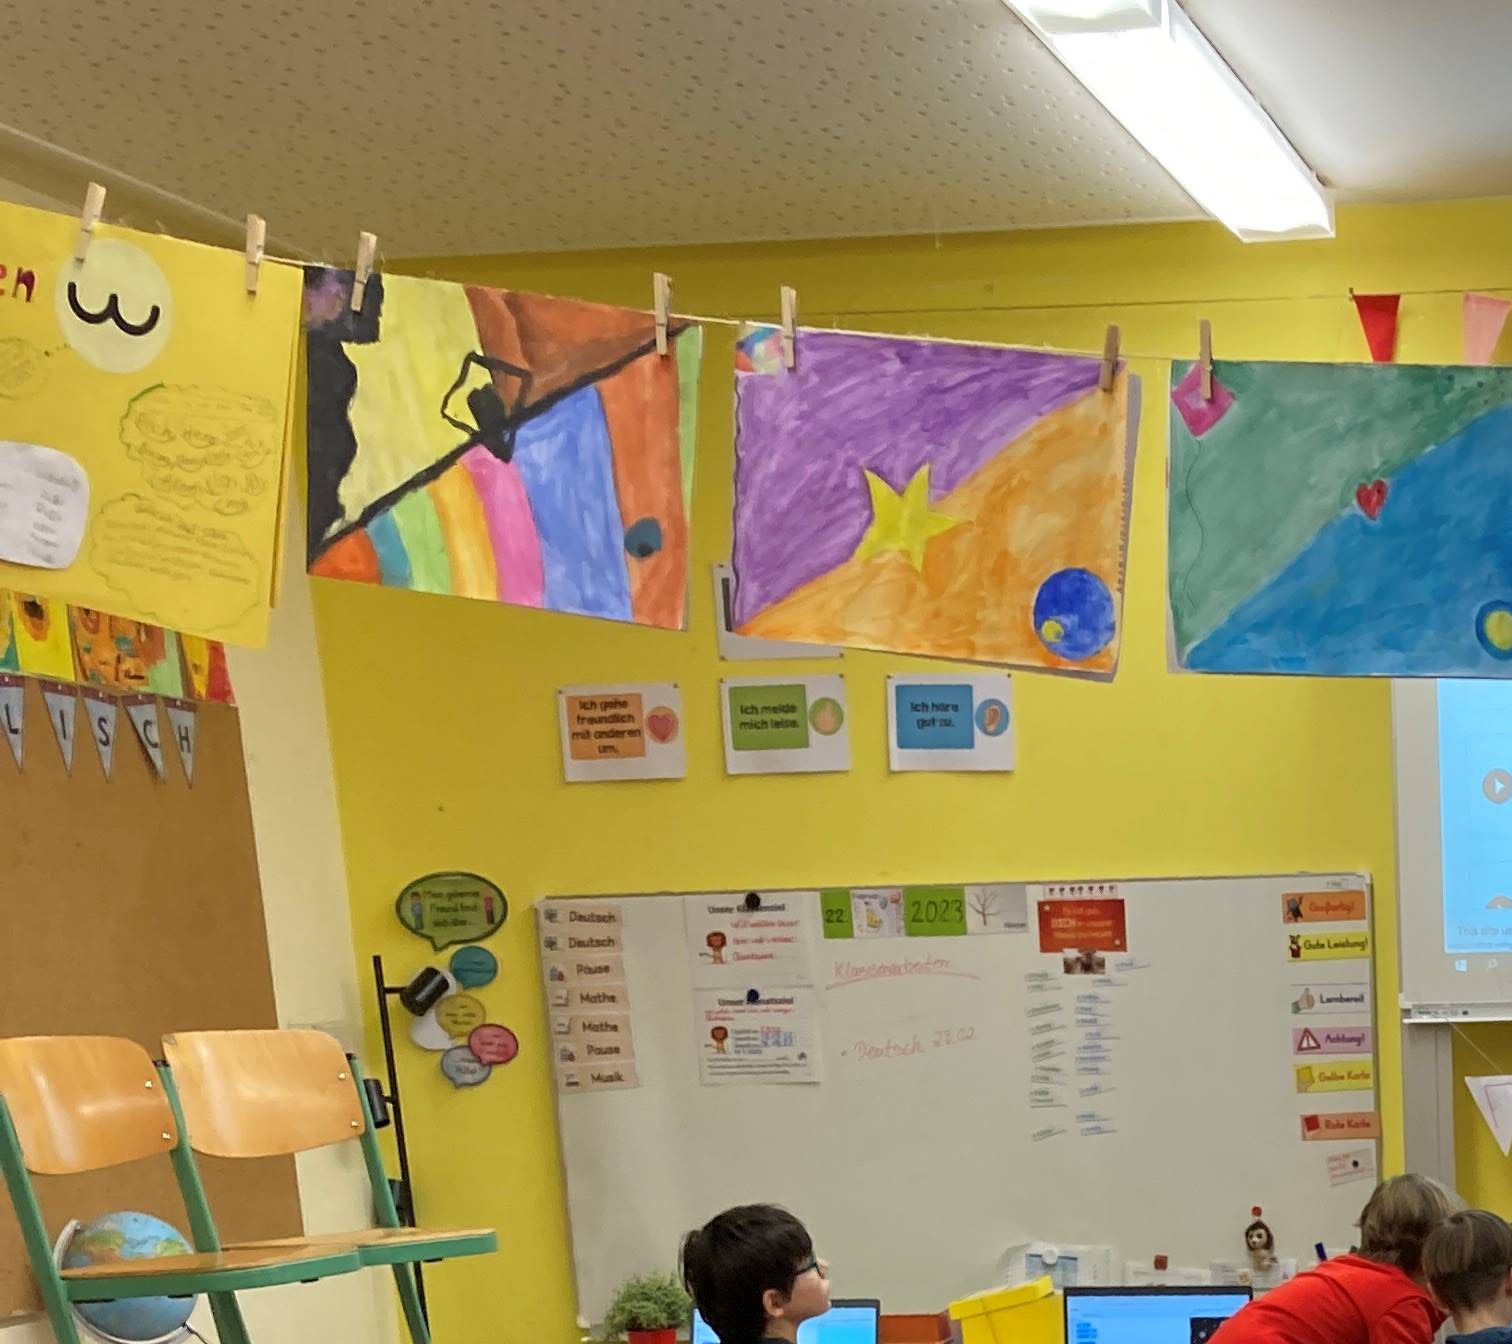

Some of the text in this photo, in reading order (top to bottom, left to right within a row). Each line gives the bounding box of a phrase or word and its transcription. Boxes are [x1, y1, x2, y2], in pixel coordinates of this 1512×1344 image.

[579, 700, 628, 712] Ich gehe
[740, 704, 797, 715] Ich melde
[910, 702, 928, 712] Ich
[577, 714, 635, 725] freundlich
[740, 719, 800, 730] mich leise.
[917, 718, 935, 730] gut
[572, 728, 642, 740] mit anderen
[569, 911, 616, 923] Deutsch
[825, 909, 845, 924] 22
[911, 900, 964, 923] 2023
[1458, 926, 1478, 936] This
[1481, 926, 1499, 936] site
[568, 936, 615, 948] Deutsch
[1303, 937, 1369, 951] Gute Leistung!
[576, 964, 610, 975] Pause
[580, 992, 616, 1004] Mathe
[582, 1021, 618, 1033] Mathe
[1325, 1032, 1365, 1047] Achtung!
[586, 1044, 620, 1056] Pause
[590, 1072, 624, 1084] Musik
[1319, 1070, 1371, 1082] Gelbe Karte
[1325, 1119, 1345, 1130] Rote
